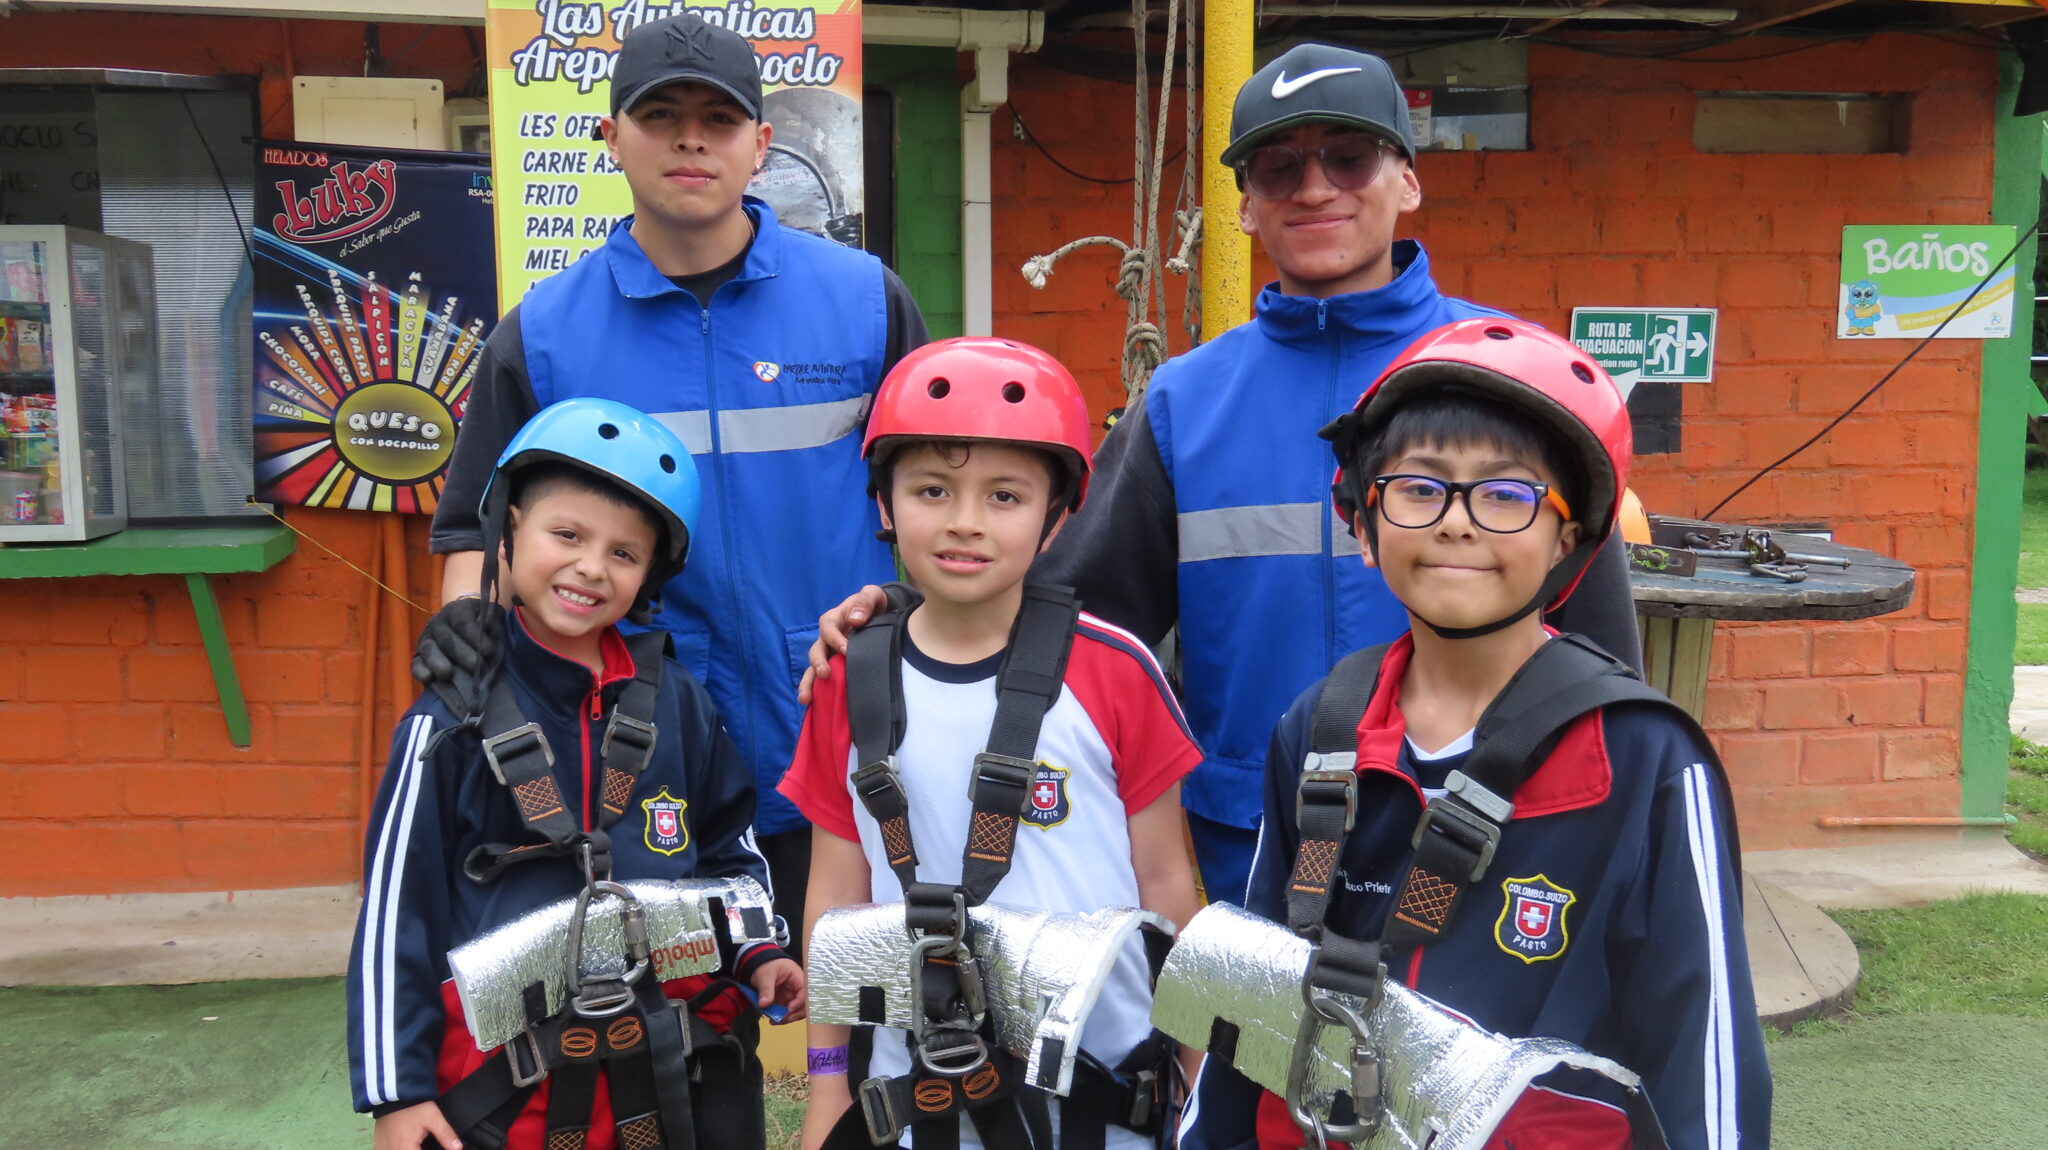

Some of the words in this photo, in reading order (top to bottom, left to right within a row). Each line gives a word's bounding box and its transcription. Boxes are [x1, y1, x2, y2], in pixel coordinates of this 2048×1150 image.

[537, 0, 603, 47] Las
[511, 36, 614, 93] Arep
[0, 124, 62, 149] OCLO
[74, 122, 98, 148] S
[521, 115, 556, 137] LES
[264, 149, 328, 167] HELADOS
[524, 151, 587, 173] CARNE
[593, 152, 624, 173] AS
[273, 159, 396, 244] Luky
[525, 184, 578, 206] FRITO
[349, 233, 376, 253] Sabor
[376, 225, 392, 243] que
[393, 210, 421, 234] Gusta
[526, 217, 574, 238] PAPA
[525, 249, 569, 270] MIEL
[1862, 233, 1989, 277] Baños
[295, 284, 334, 346] AREQUIPE
[329, 349, 353, 384] COCO
[327, 269, 357, 333] AREQUIPE
[350, 337, 371, 379] PASAS
[1588, 322, 1616, 338] RUTA
[1618, 322, 1632, 338] DE
[290, 326, 321, 361] MORA
[440, 359, 460, 386] RON
[458, 317, 485, 357] PASAS
[1618, 359, 1638, 368] route
[348, 411, 441, 440] QUESO
[350, 437, 374, 447] CON
[378, 439, 440, 451] BOCADILLO
[1032, 809, 1058, 819] PASTO
[657, 836, 678, 846] PASTO
[1513, 935, 1547, 950] PASTO
